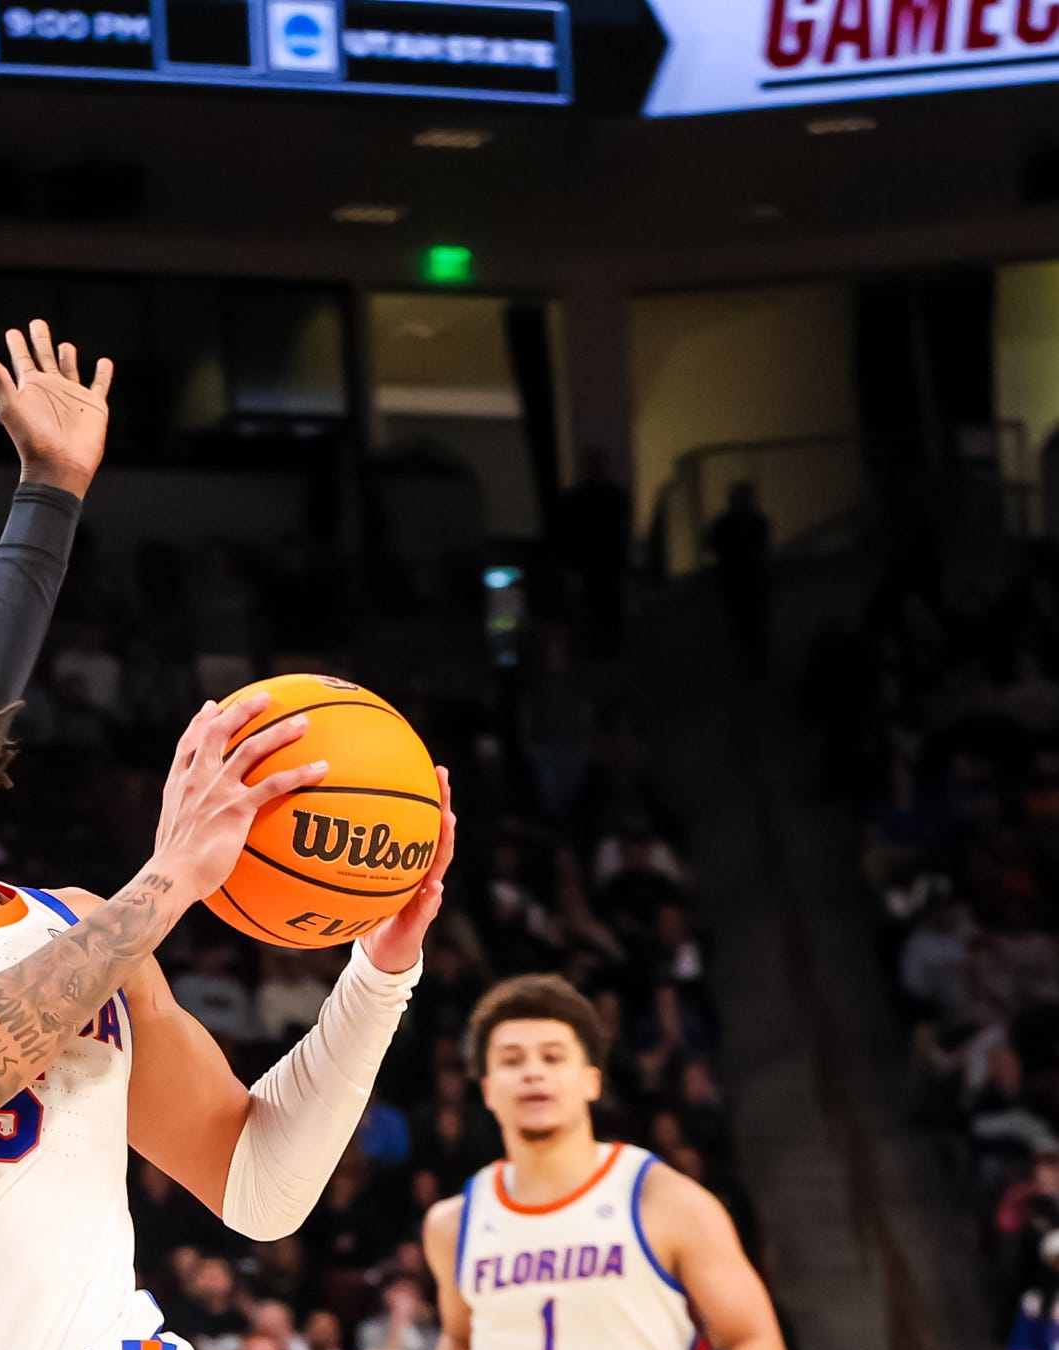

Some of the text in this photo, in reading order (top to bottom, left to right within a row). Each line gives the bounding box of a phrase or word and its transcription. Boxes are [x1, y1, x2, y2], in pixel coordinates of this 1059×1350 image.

[2, 7, 150, 42] 9:00 PM
[292, 810, 434, 871] Wilson
[473, 1245, 624, 1293] FLORIDA
